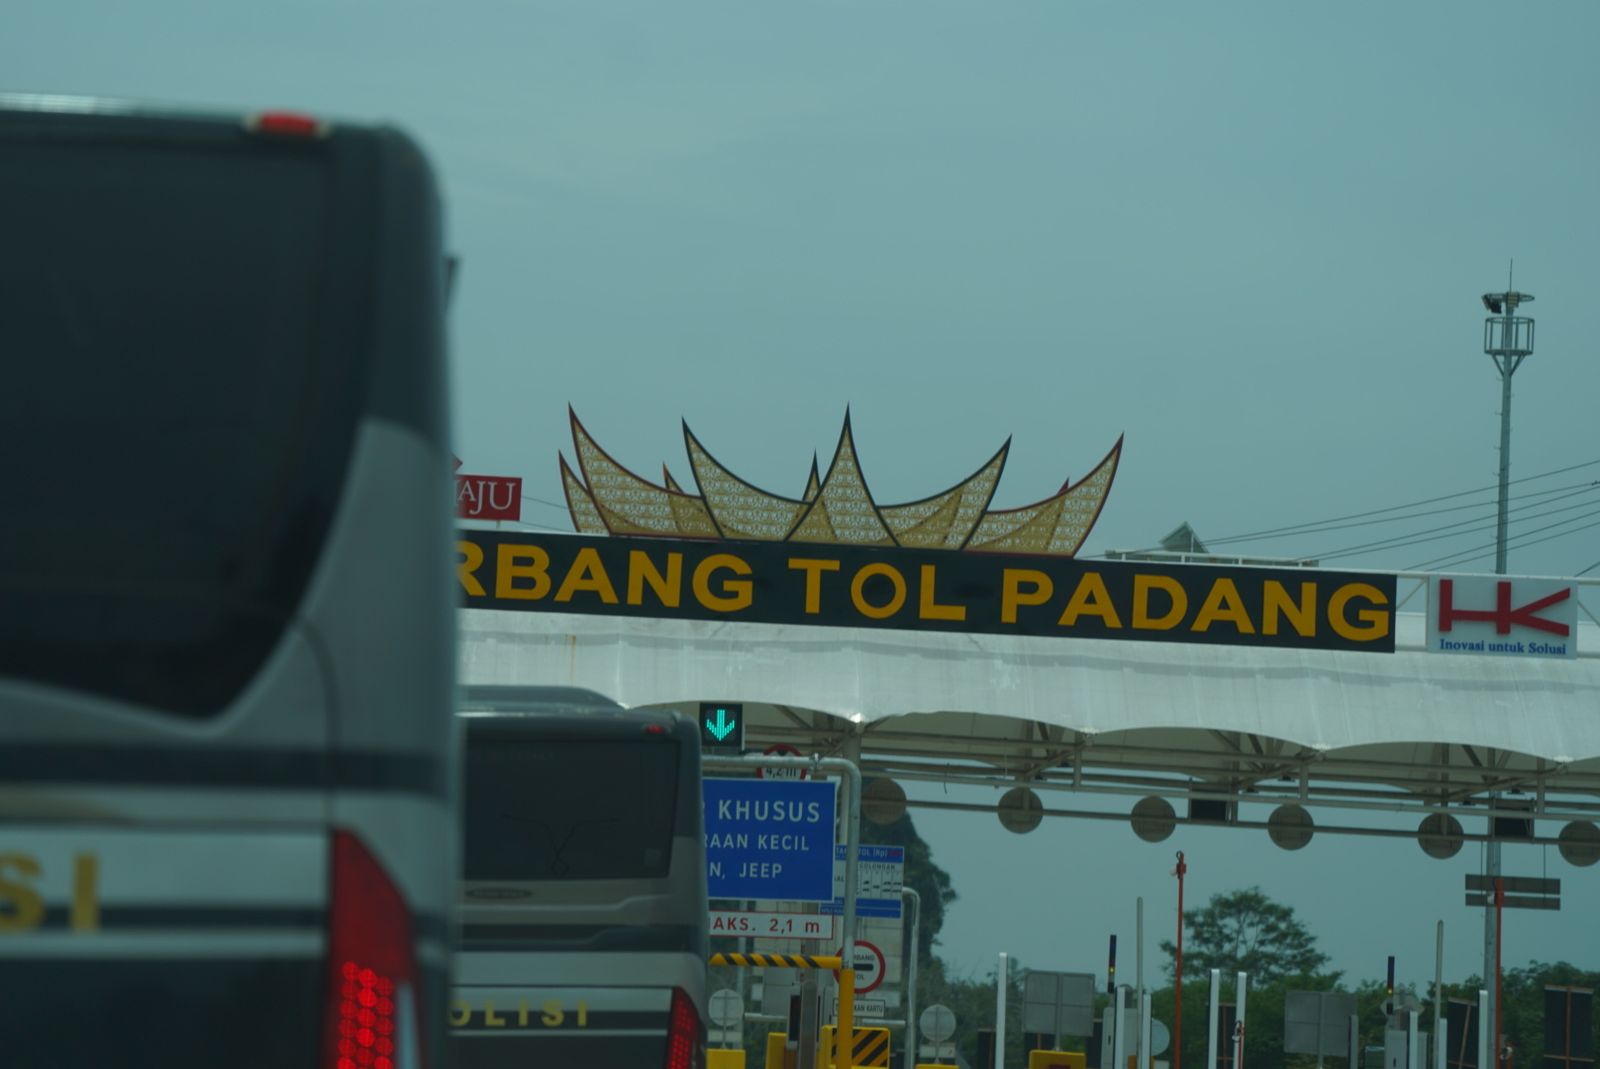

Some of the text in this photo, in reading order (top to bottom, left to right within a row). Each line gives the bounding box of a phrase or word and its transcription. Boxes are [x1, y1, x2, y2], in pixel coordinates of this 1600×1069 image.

[454, 479, 516, 515] AJU
[788, 557, 966, 622] TOL
[1001, 568, 1389, 641] PADANG
[1438, 579, 1571, 637] HK
[1440, 639, 1567, 655] Inovasi untuk Solusi
[718, 799, 820, 823] KHUSUS
[758, 834, 810, 851] KECIL
[739, 862, 783, 879] JEEP
[708, 916, 820, 934] AKS. 2,1 m
